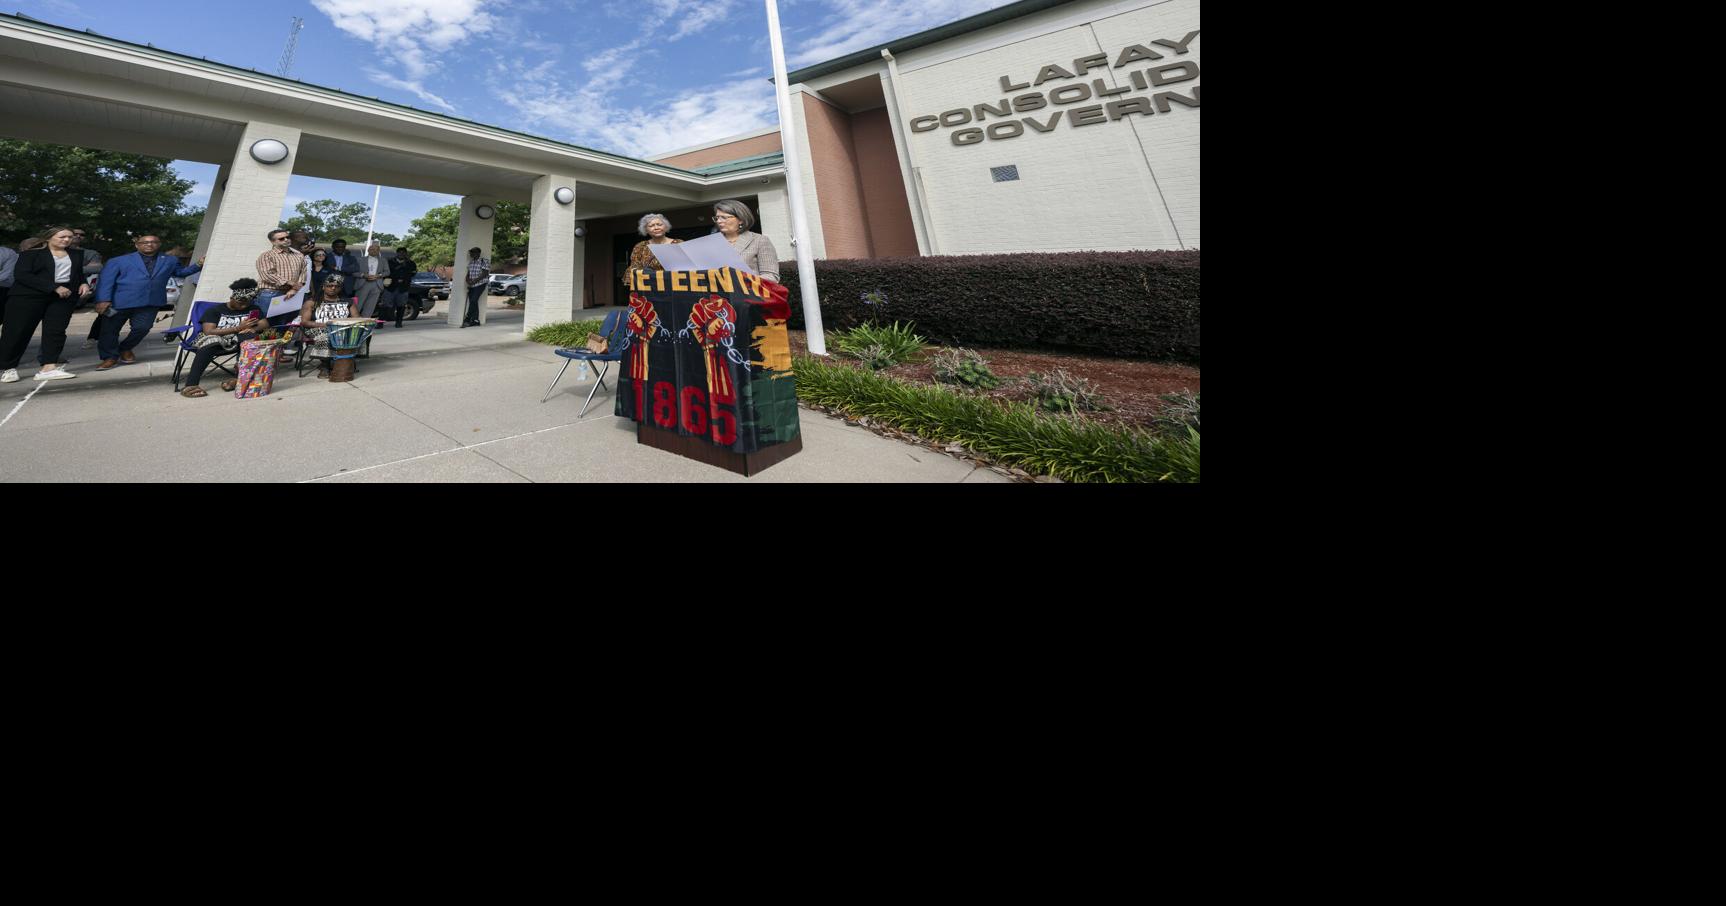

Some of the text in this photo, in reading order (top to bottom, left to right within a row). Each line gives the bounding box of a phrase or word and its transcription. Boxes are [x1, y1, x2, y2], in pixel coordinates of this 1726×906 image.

[1000, 30, 1200, 93] LAFAY
[909, 61, 1200, 133] CONSOLID
[632, 379, 737, 446] 1865
